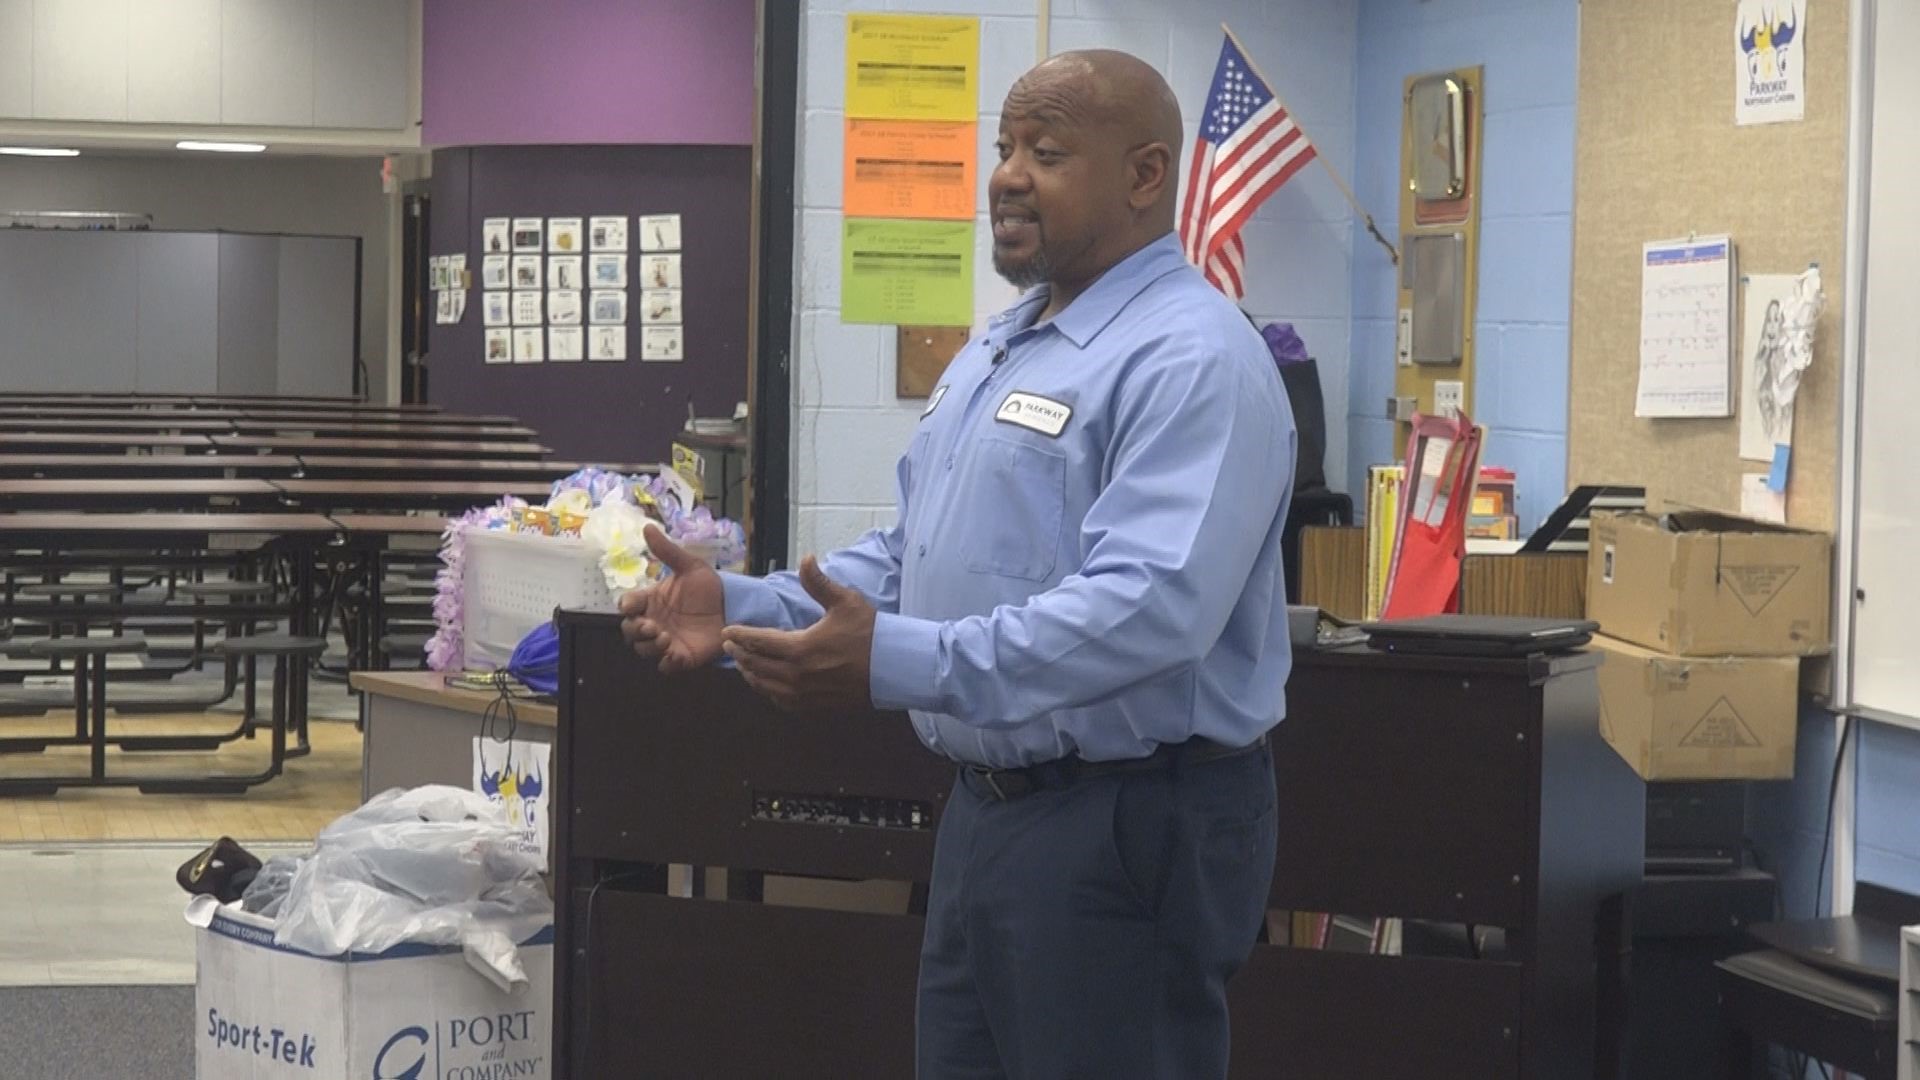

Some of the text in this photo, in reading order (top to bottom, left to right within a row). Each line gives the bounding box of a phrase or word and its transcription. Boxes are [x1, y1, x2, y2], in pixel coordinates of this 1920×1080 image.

[1025, 403, 1064, 420] PARKWAY
[208, 1007, 316, 1069] Sport-Tek
[450, 1010, 535, 1048] PORT
[481, 1043, 506, 1062] and
